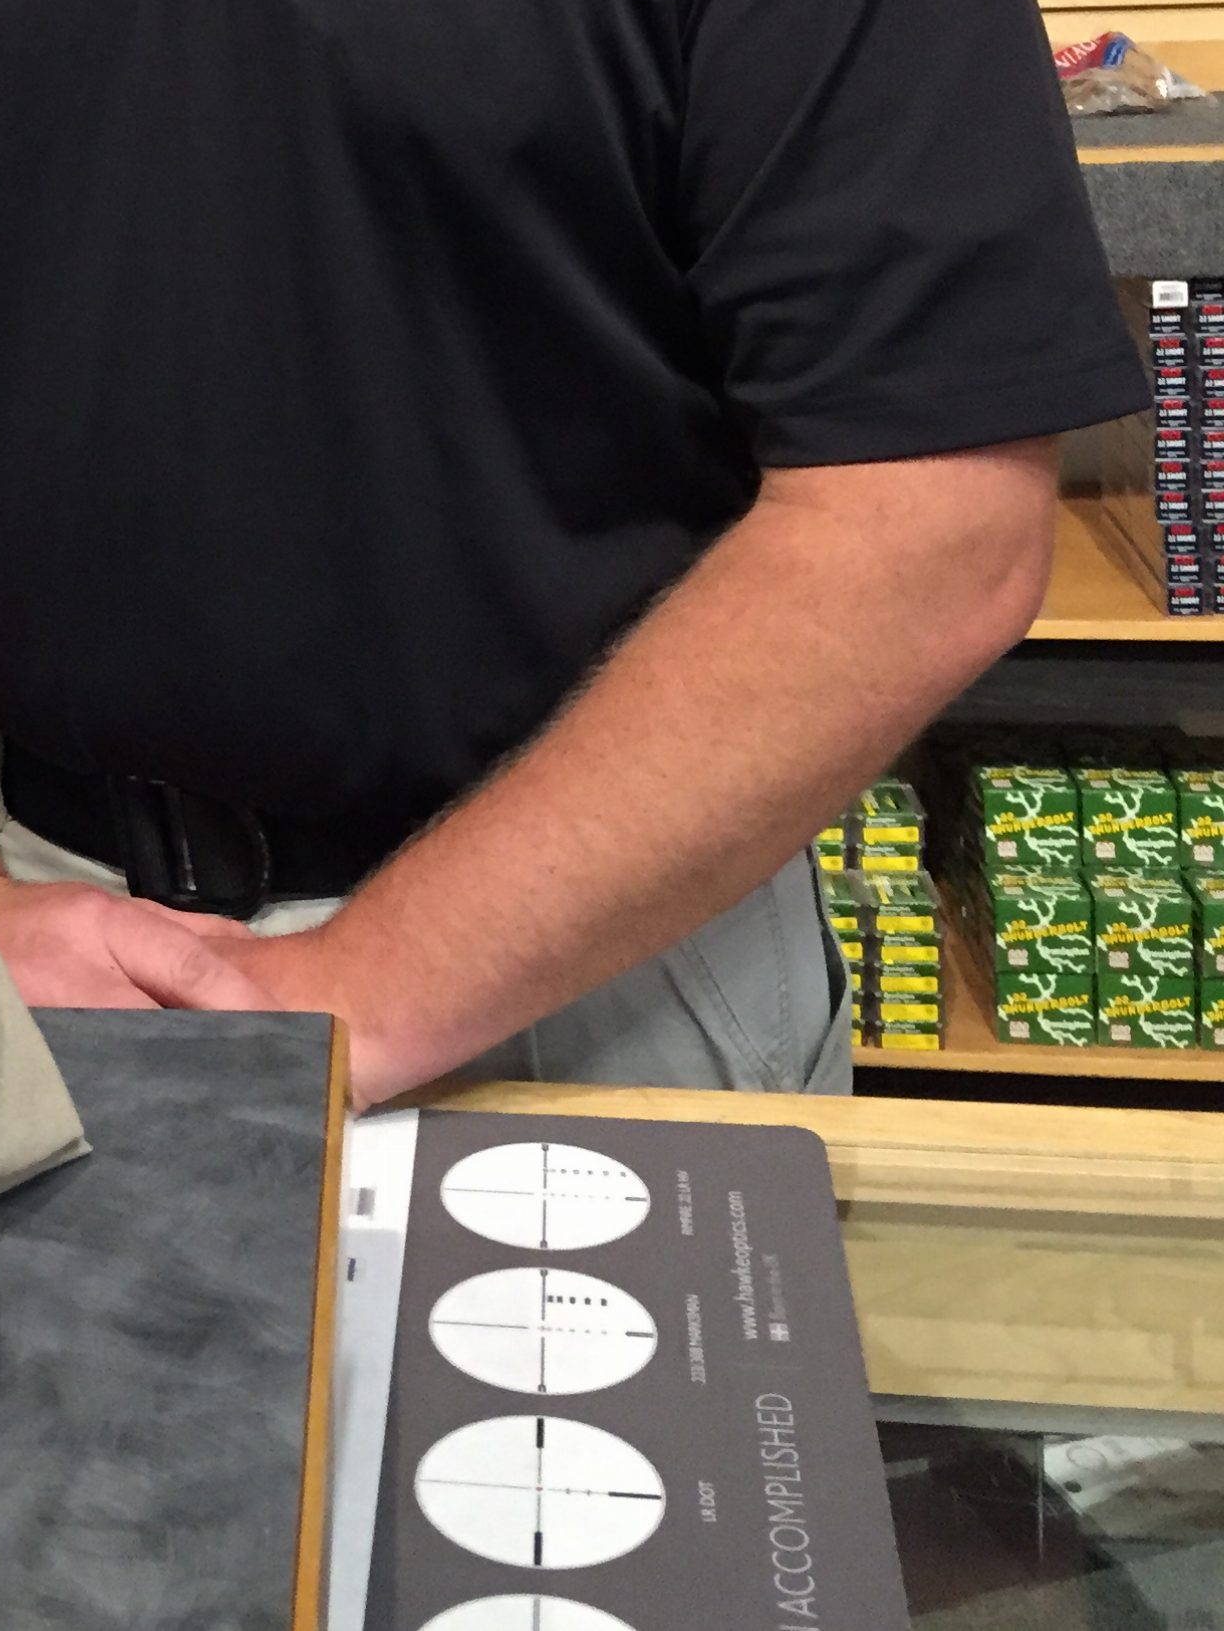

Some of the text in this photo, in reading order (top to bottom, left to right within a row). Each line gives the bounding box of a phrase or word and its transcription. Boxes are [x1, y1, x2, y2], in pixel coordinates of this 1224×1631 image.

[728, 1190, 758, 1340] www.hawkeoptics.com
[698, 1480, 717, 1506] DOT
[755, 1392, 819, 1619] ACCOMPLISHED
